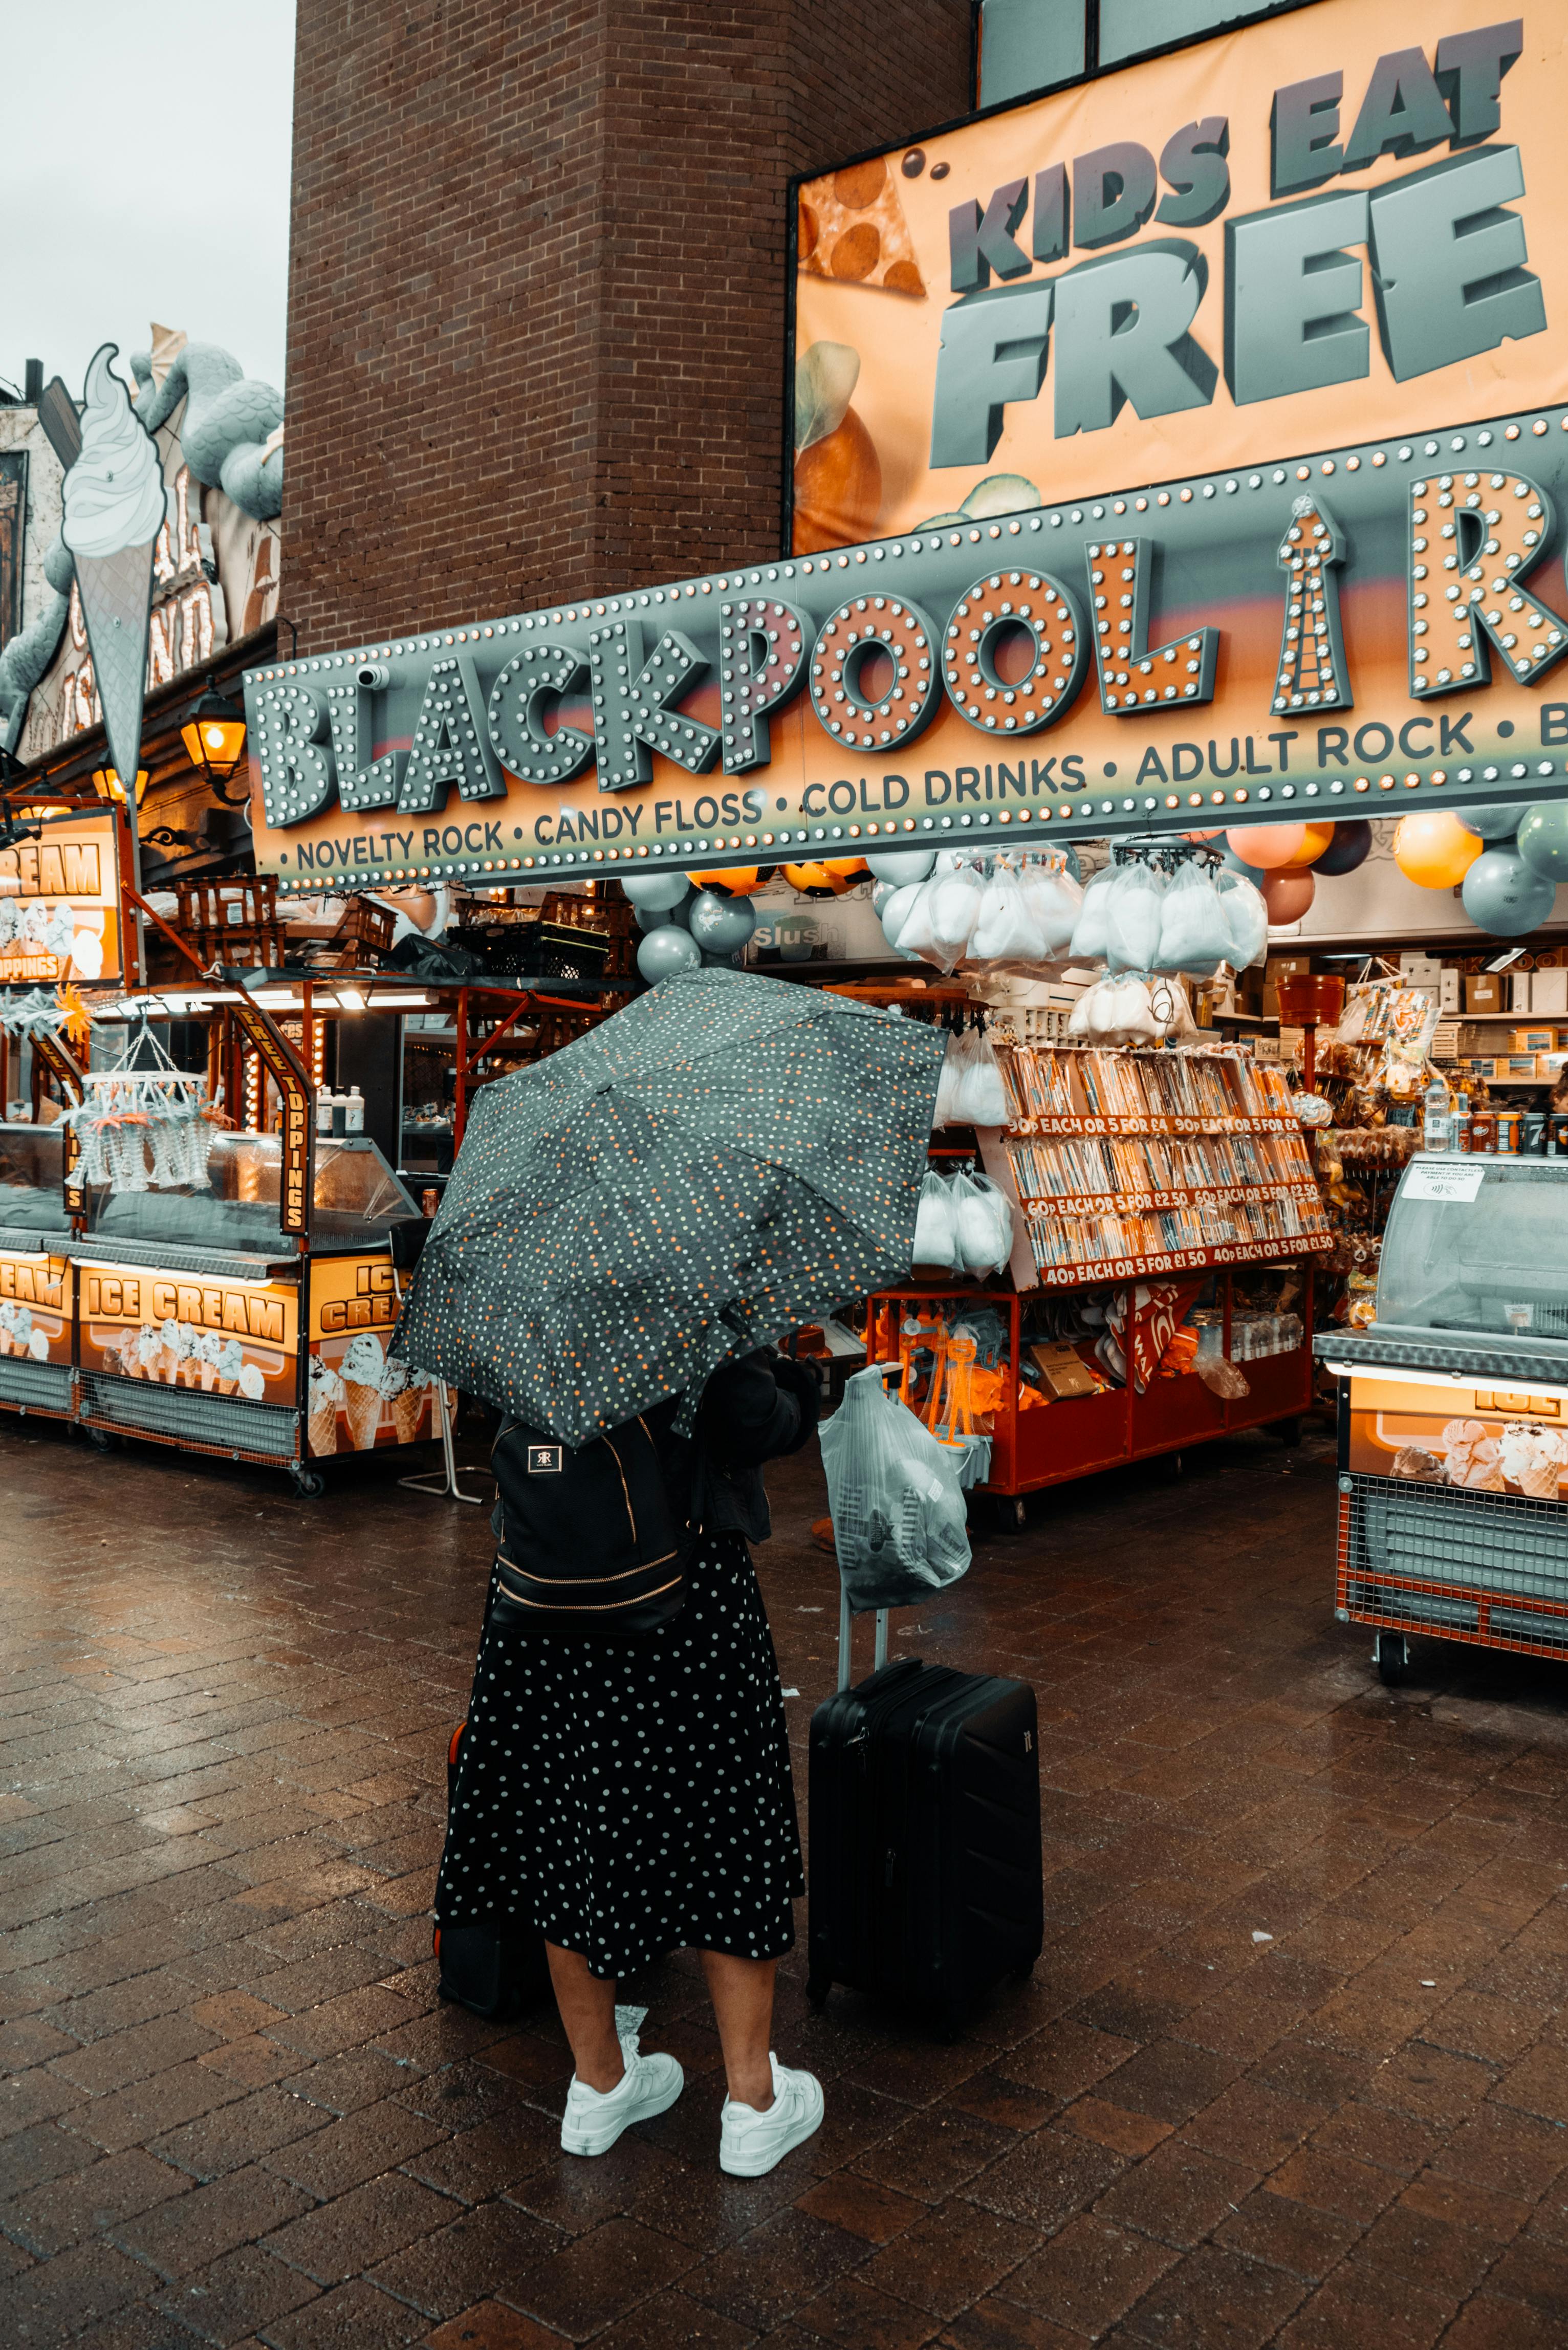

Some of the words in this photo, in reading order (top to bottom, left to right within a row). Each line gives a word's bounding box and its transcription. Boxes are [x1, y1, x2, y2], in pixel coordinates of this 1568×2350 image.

[949, 116, 1230, 294] KIDS
[1270, 18, 1524, 201] EAT
[929, 144, 1549, 469] FREE
[255, 536, 1219, 829] BLACKPOOL
[1407, 468, 1568, 699] R
[297, 831, 413, 870] NOVELTY
[423, 821, 505, 858] ROCK
[535, 804, 643, 846] CANDY
[654, 790, 764, 833] FLOSS
[802, 776, 910, 818] COLD
[924, 755, 1085, 806] DRINKS
[1135, 731, 1299, 786] ADULT
[1318, 713, 1475, 769] ROCK
[754, 923, 839, 946] Slush
[0, 955, 58, 980] PPINGS
[240, 1010, 287, 1071] FREE
[282, 1076, 304, 1228] TOPPINGS
[1009, 1118, 1039, 1133] 90p
[1040, 1118, 1082, 1133] EACH
[1084, 1118, 1106, 1133] OR
[1107, 1117, 1119, 1133] 5
[1120, 1118, 1149, 1133] FOR
[1151, 1118, 1168, 1132] £4
[1175, 1118, 1200, 1132] 90p
[1200, 1118, 1234, 1132] EACH
[1235, 1118, 1252, 1132] OR
[1252, 1118, 1261, 1132] 5
[1262, 1118, 1284, 1132] FOR
[1285, 1118, 1299, 1130] £4
[1028, 1200, 1056, 1216] 60p
[1056, 1197, 1094, 1214] EACH
[1095, 1195, 1115, 1212] OR
[1115, 1195, 1126, 1210] 5
[1126, 1193, 1153, 1210] FOR
[1154, 1191, 1188, 1207] £2.50
[1195, 1190, 1216, 1204] 60p
[1216, 1188, 1246, 1203] EACH
[1246, 1187, 1261, 1202] OR
[1261, 1186, 1271, 1200] 5
[1290, 1184, 1318, 1198] £2.50
[1047, 1268, 1075, 1285] 40p
[1076, 1262, 1114, 1281] EACH
[1115, 1259, 1136, 1277] OR
[1136, 1257, 1147, 1274] 5
[1146, 1254, 1173, 1272] FOR
[1214, 1248, 1235, 1262] 40p
[1235, 1244, 1263, 1260] EACH
[1264, 1242, 1280, 1257] OR
[1280, 1241, 1289, 1255] 5
[1289, 1237, 1311, 1253] FOR
[1310, 1235, 1334, 1250] £1.50
[89, 1278, 140, 1317] ICE
[153, 1282, 285, 1343] CREAM
